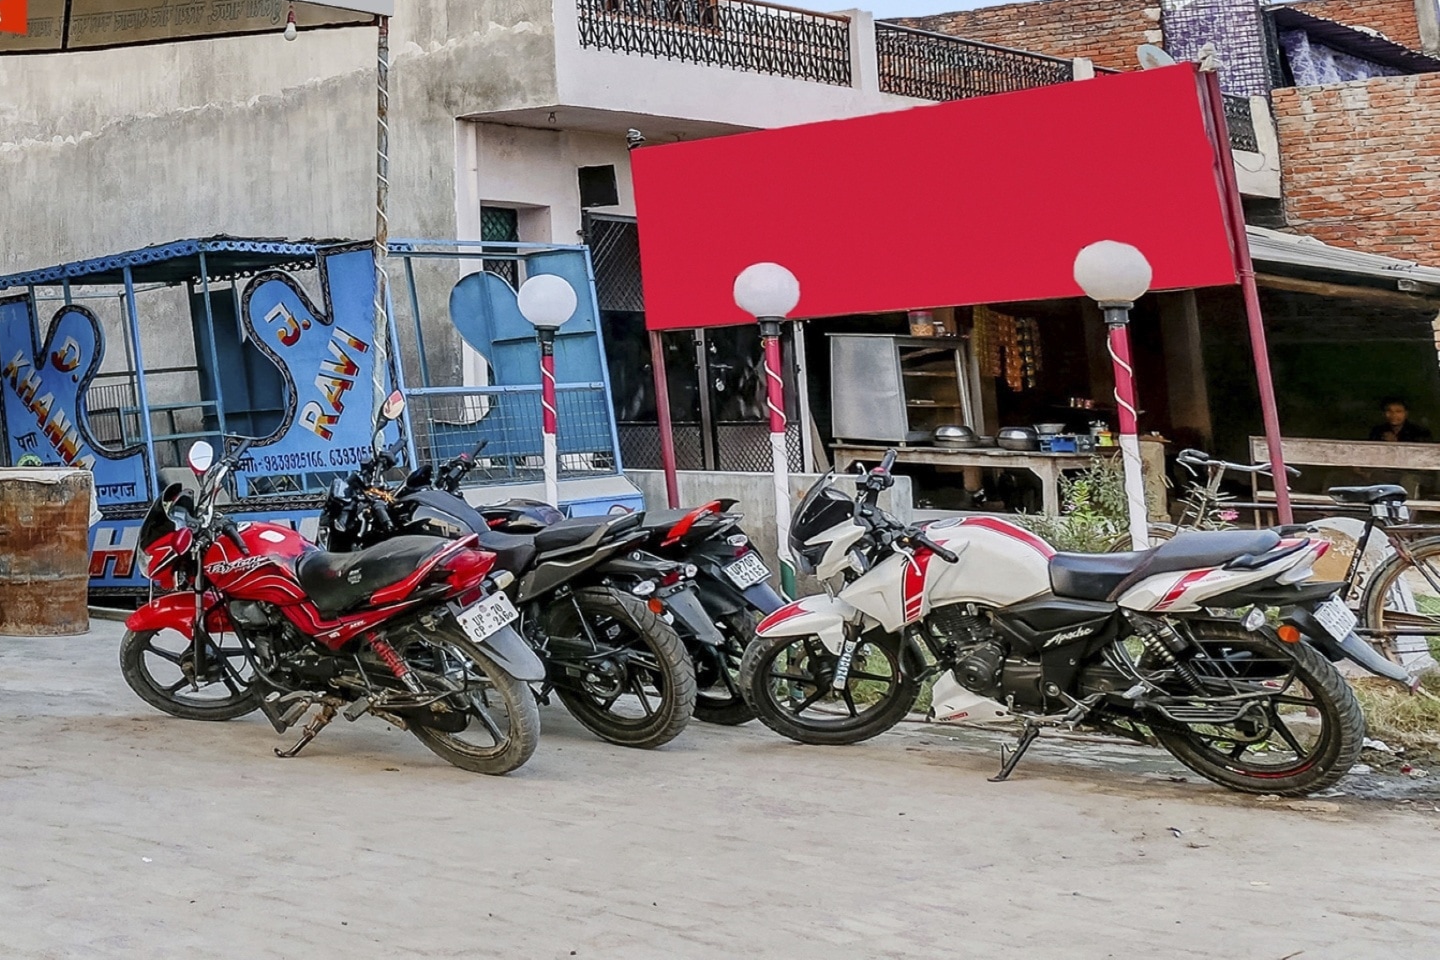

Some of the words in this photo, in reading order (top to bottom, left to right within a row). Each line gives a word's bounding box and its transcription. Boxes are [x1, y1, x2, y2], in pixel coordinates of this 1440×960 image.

[264, 302, 311, 347] J.
[298, 326, 370, 441] RAVI
[14, 431, 38, 451] पता
